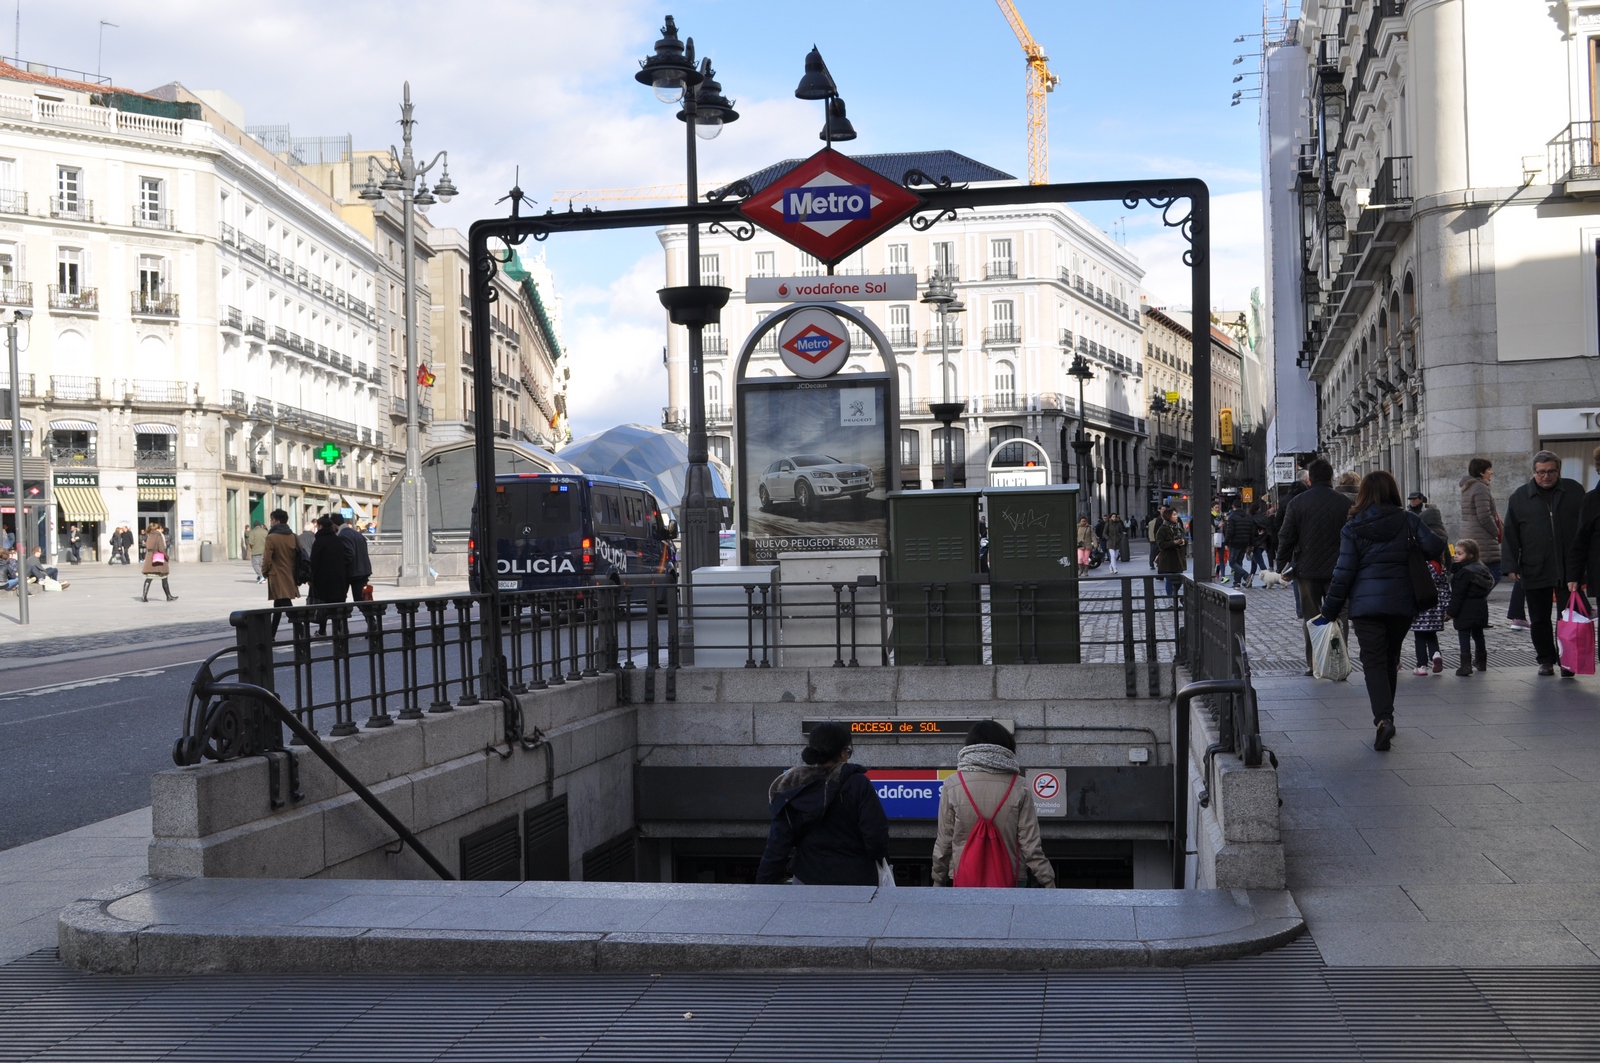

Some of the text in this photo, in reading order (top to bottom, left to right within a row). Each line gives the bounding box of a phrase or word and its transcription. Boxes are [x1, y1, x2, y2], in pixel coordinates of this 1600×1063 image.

[790, 192, 864, 215] Metro
[796, 281, 887, 295] vodafone Sol
[797, 339, 829, 350] Metro
[56, 477, 96, 485] RODILLA
[755, 537, 878, 548] NUEVO PEUGEOT 508 RXH
[595, 536, 627, 573] POLICÍA
[755, 551, 772, 559] CON
[497, 555, 576, 573] OLICÍA
[851, 722, 940, 732] ACCESO de SOL
[876, 785, 932, 799] dafone
